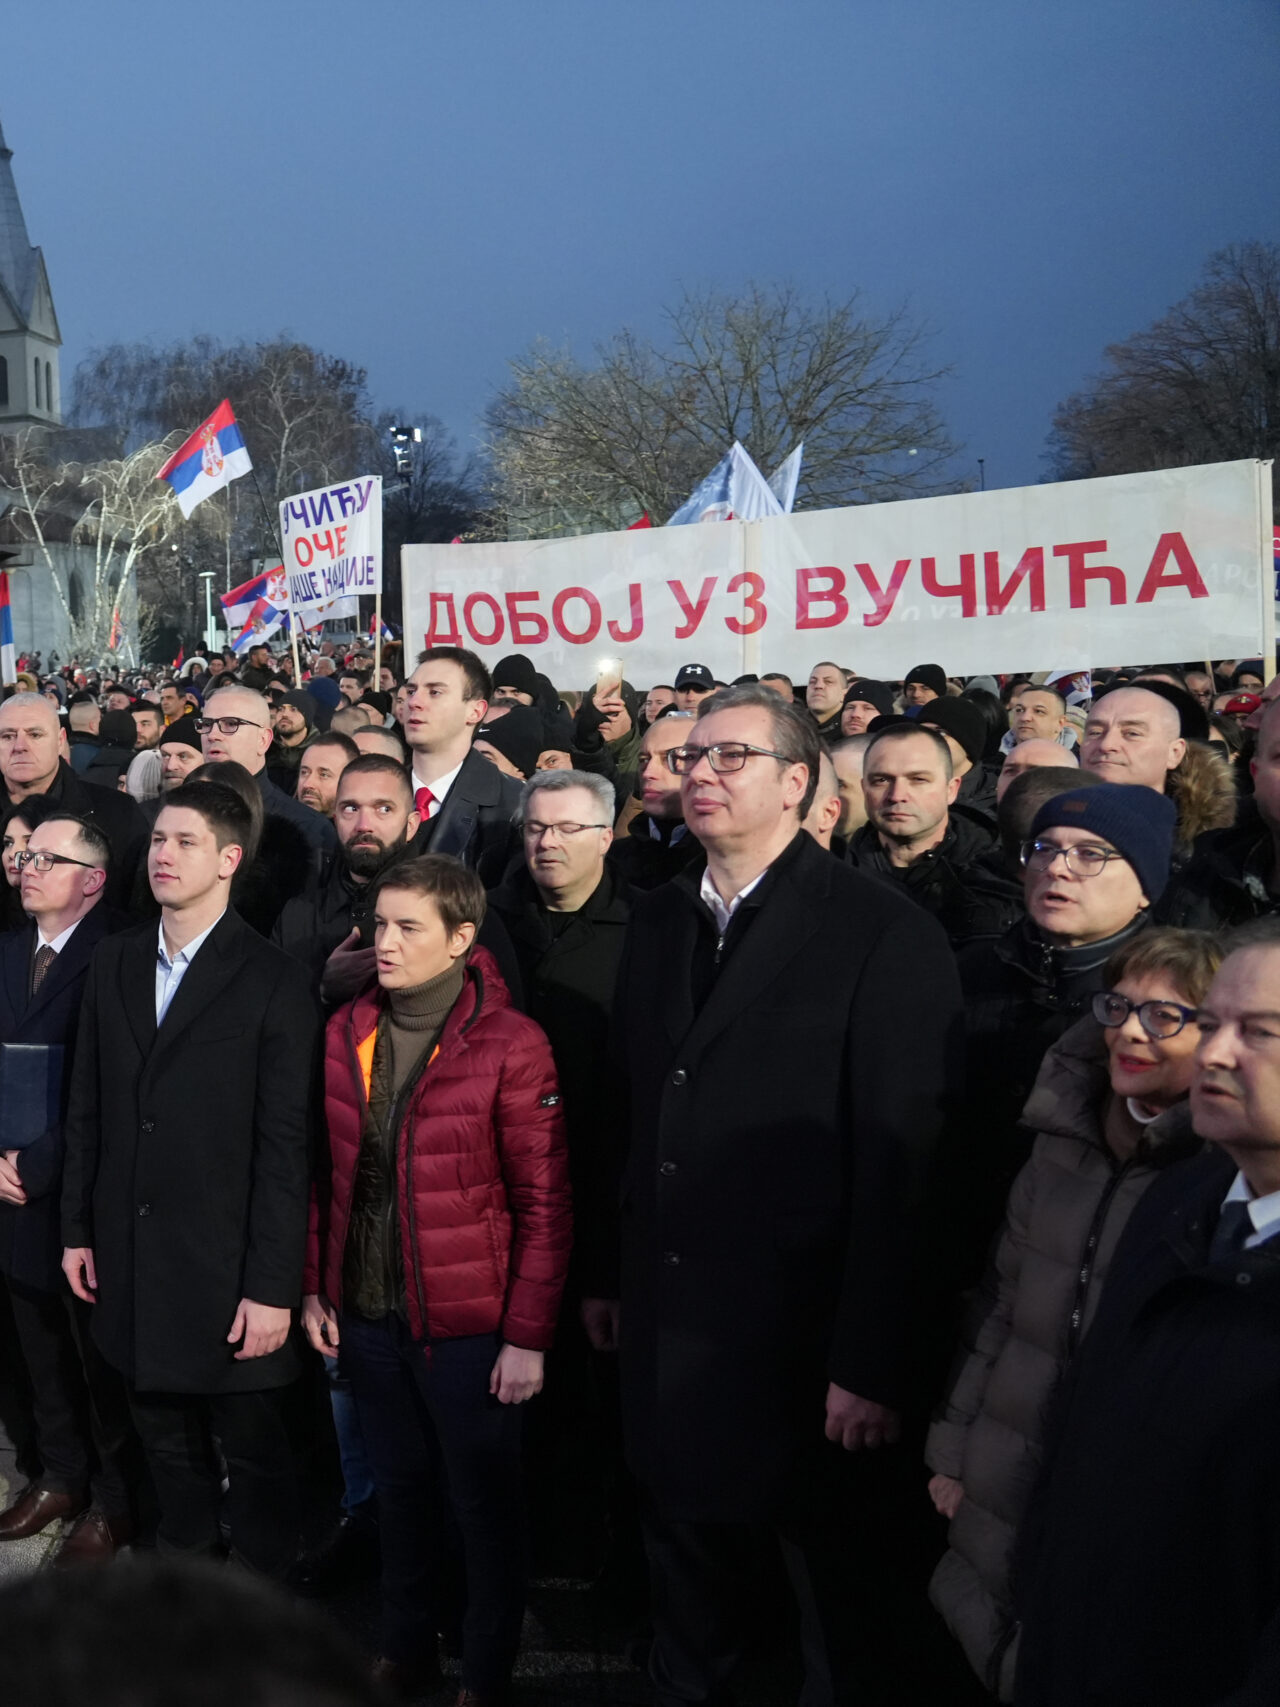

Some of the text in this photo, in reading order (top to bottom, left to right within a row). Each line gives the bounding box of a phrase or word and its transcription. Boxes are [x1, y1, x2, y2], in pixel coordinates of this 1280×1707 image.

[284, 480, 373, 534] УЧИЋУ
[294, 525, 347, 567] ОЧЕ
[322, 556, 374, 597] НАЦИЈЕ
[424, 583, 645, 650] ДОБОЈ
[666, 572, 768, 640] УЗ
[795, 532, 1210, 630] ВУЧИЋА
